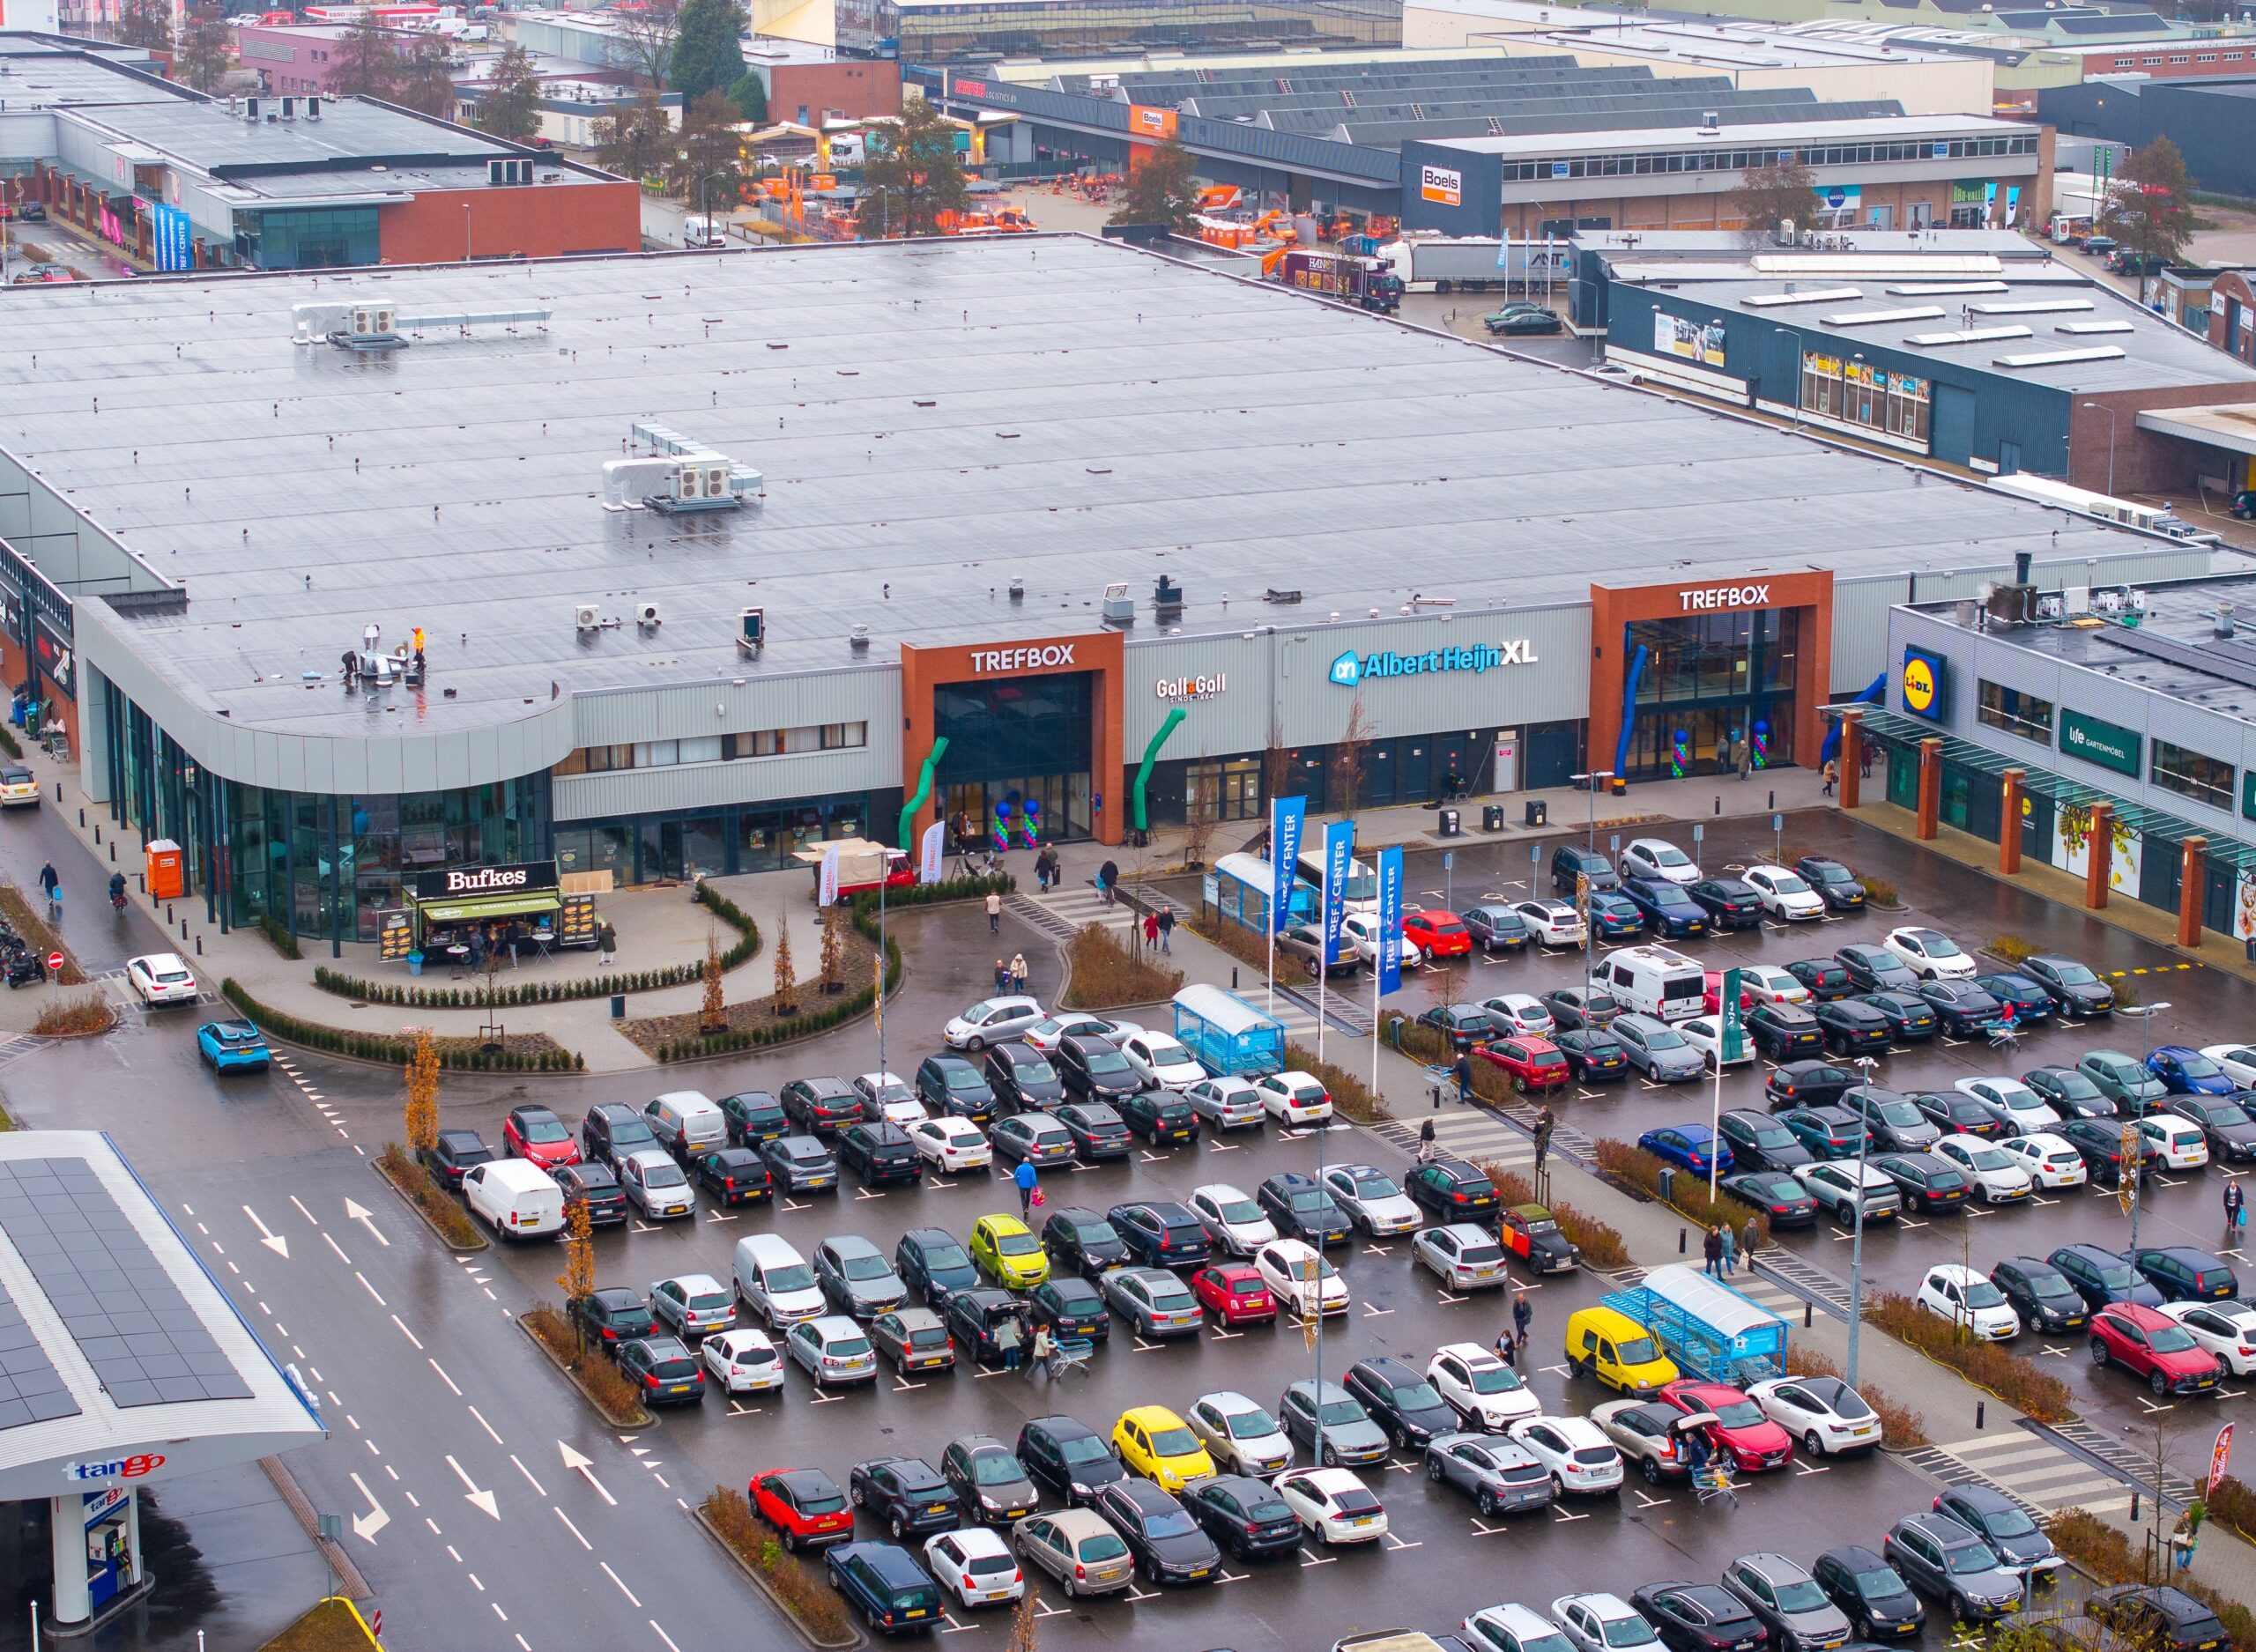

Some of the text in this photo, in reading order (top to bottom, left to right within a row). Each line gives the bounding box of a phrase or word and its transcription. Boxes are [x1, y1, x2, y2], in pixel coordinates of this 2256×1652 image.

[985, 91, 1010, 102] LOGISTICS
[1144, 113, 1161, 124] Boels
[1424, 170, 1458, 189] Boels
[1679, 584, 1770, 611] TREFBOX
[970, 644, 1075, 672] TREFBOX
[1363, 650, 1438, 678] Albert
[1169, 693, 1214, 704] SINDS 1884
[2069, 726, 2126, 759] life GARTENMÖBEL
[1282, 813, 1296, 870] CENTER
[448, 868, 527, 891] Bufkes
[1329, 839, 1346, 943] TREF CENTER
[1385, 866, 1396, 973] TREF CENTER
[63, 1452, 166, 1481] tango
[89, 1487, 123, 1512] tango
